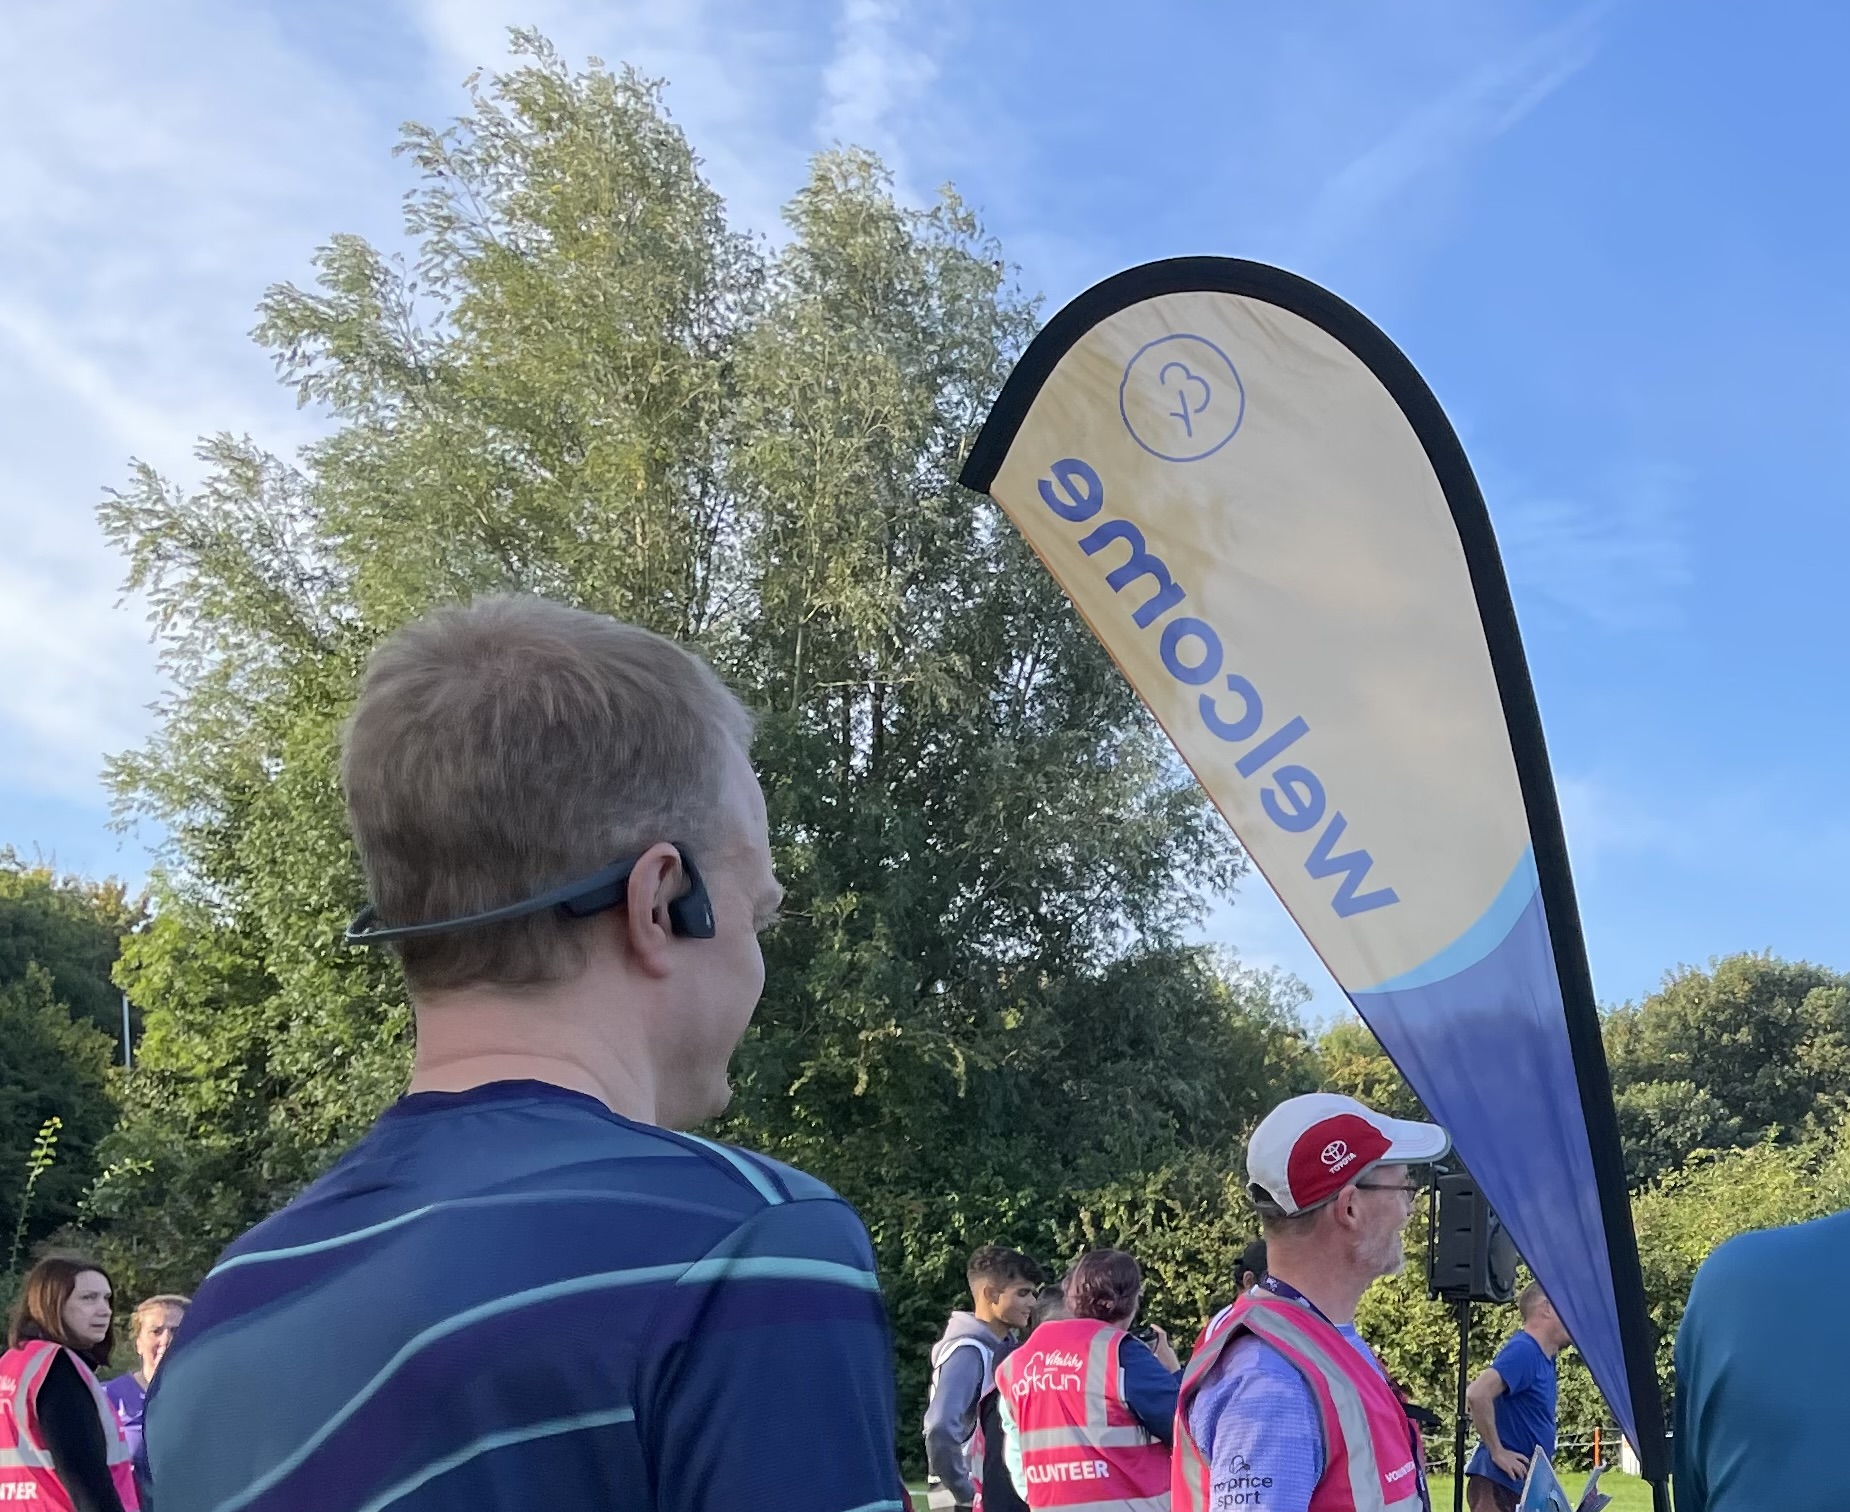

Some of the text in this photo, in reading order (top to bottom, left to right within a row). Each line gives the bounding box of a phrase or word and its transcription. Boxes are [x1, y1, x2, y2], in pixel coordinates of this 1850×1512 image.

[1329, 1152, 1357, 1174] TOYOTA
[1026, 1460, 1110, 1483] OLUNTEER
[1228, 1474, 1273, 1493] price
[1217, 1491, 1261, 1510] sport
